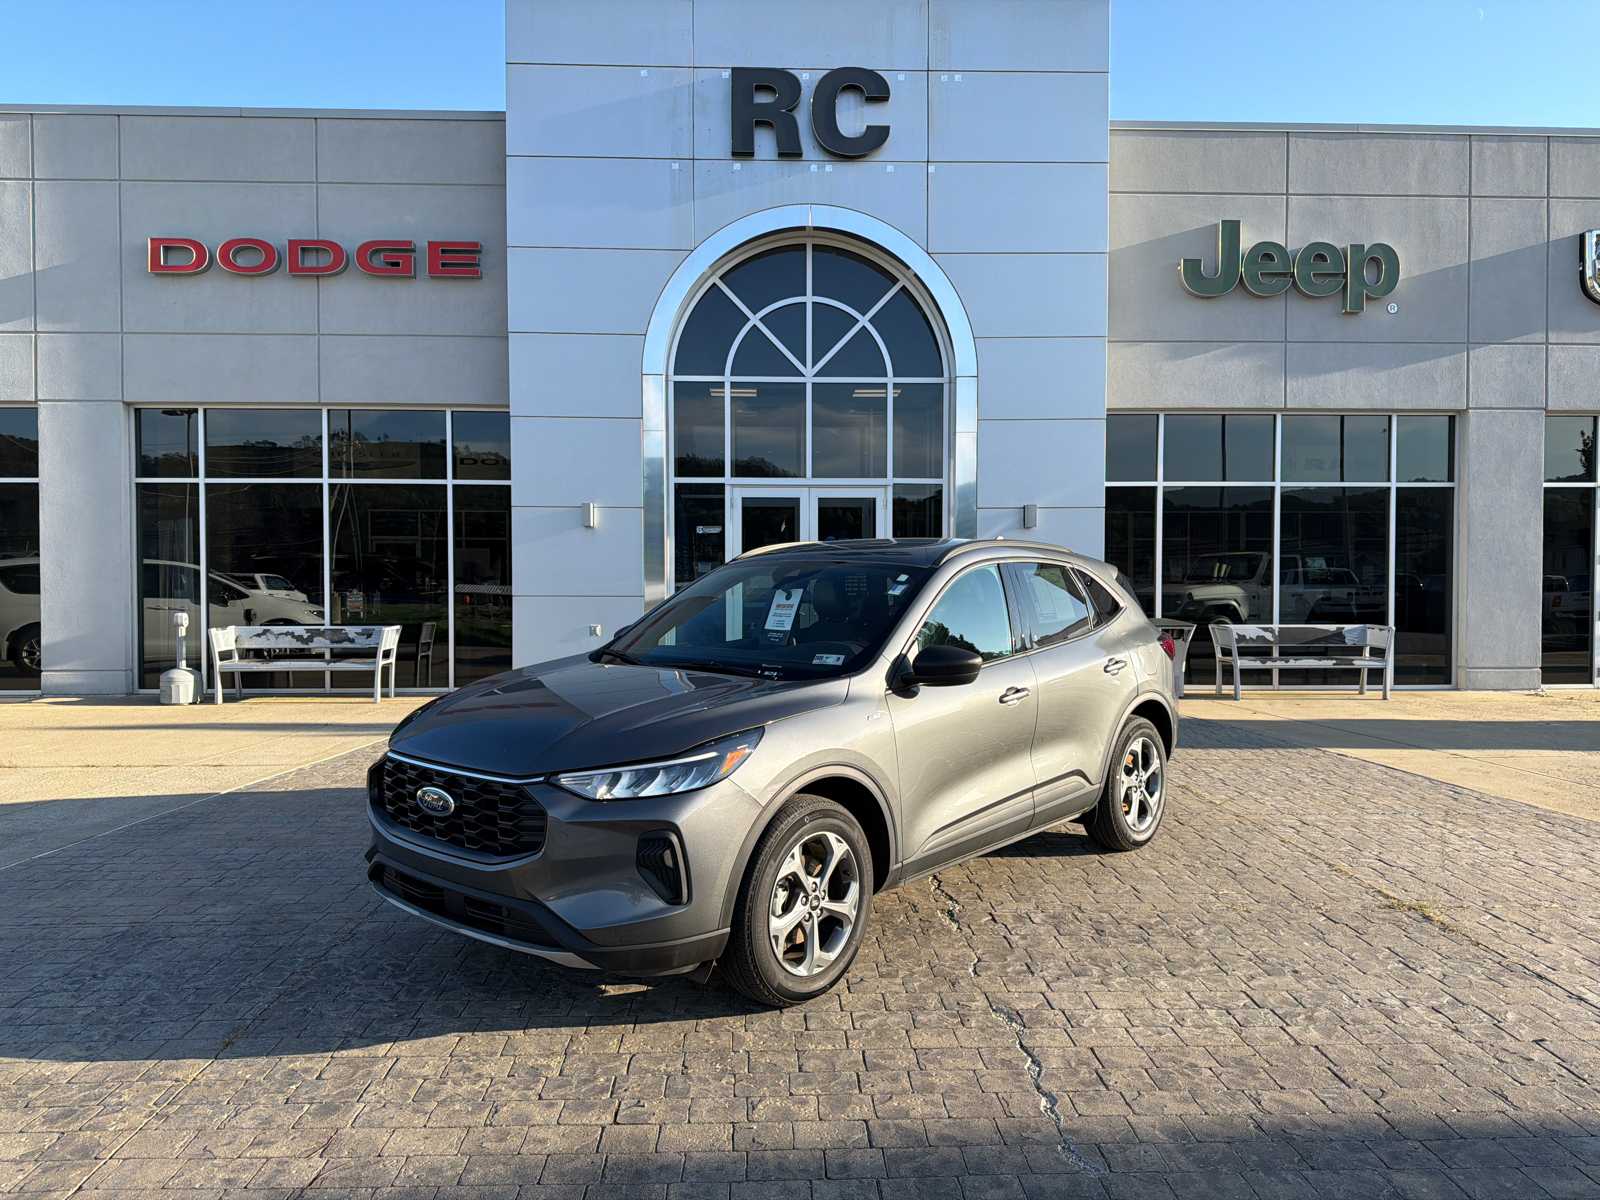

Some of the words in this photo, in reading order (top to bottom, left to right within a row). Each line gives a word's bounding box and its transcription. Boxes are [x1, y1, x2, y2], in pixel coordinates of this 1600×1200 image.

[731, 66, 891, 160] RC
[148, 237, 483, 278] DODGE
[1177, 219, 1401, 314] Jeep
